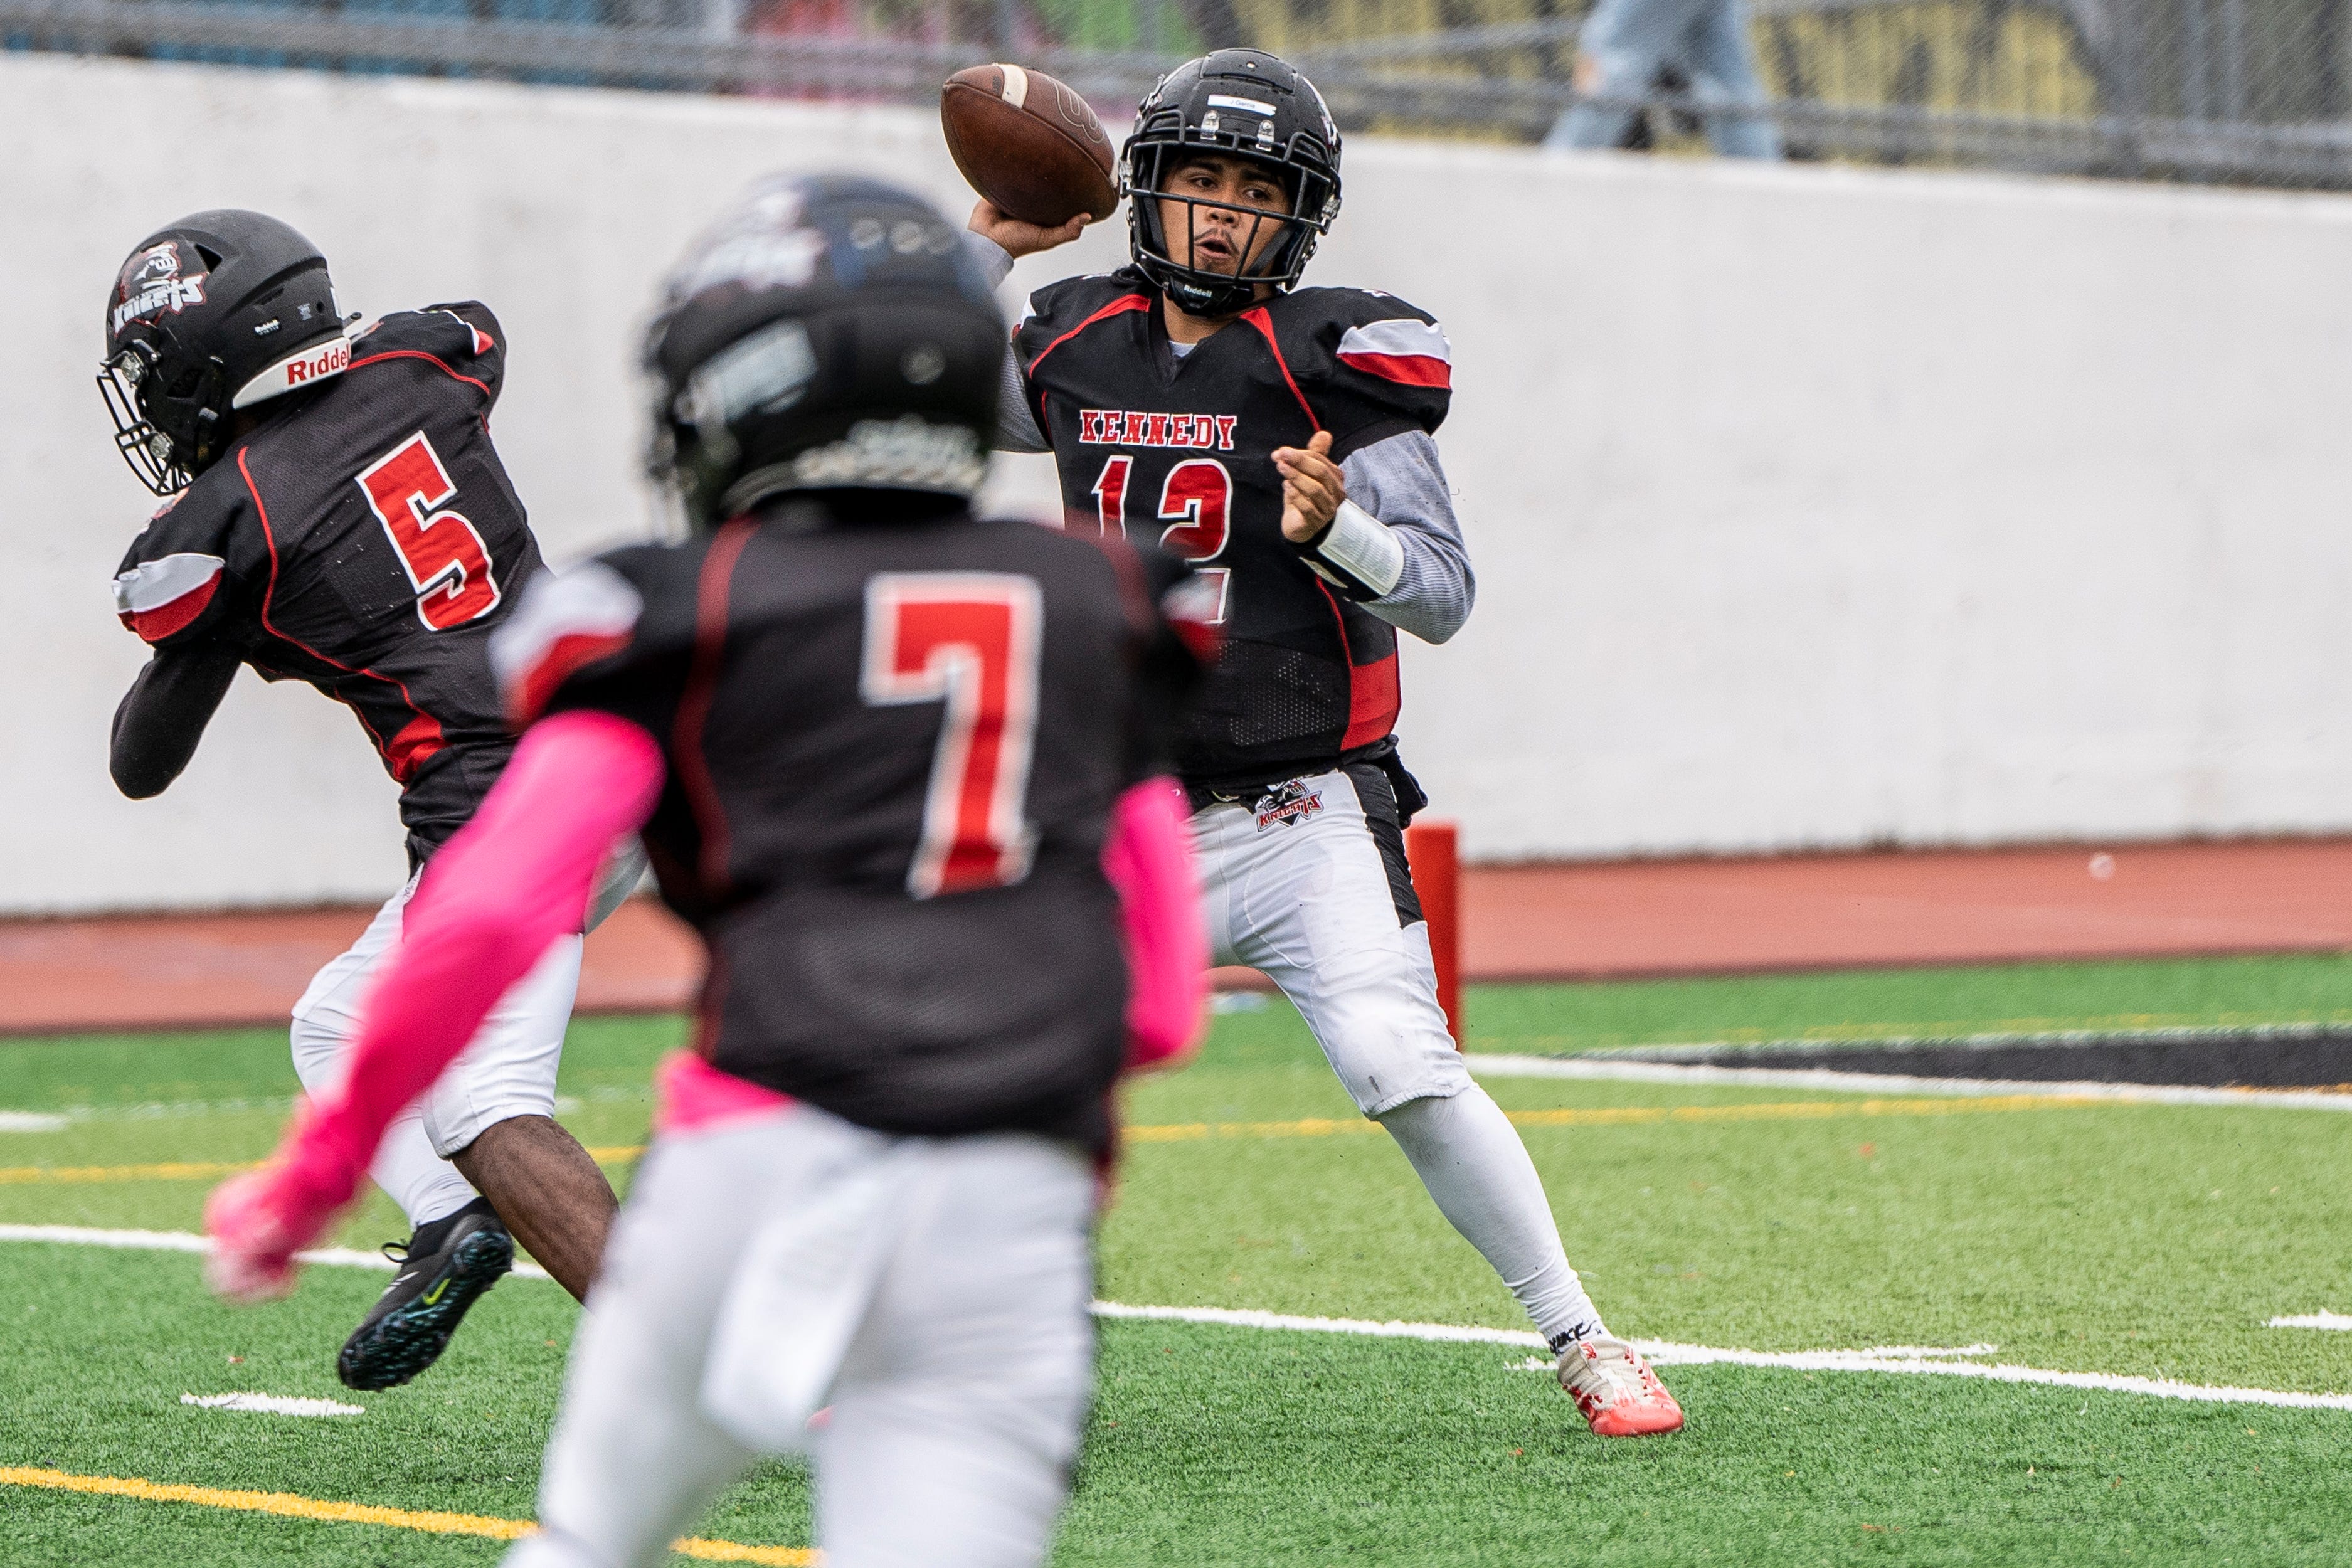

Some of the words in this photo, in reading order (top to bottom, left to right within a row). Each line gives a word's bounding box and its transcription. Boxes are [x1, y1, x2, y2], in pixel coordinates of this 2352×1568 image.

[1184, 284, 1212, 298] Riddell
[1079, 410, 1237, 450] KENNEDY
[354, 430, 501, 631] 5
[1091, 455, 1234, 625] 12
[858, 571, 1044, 901] 7
